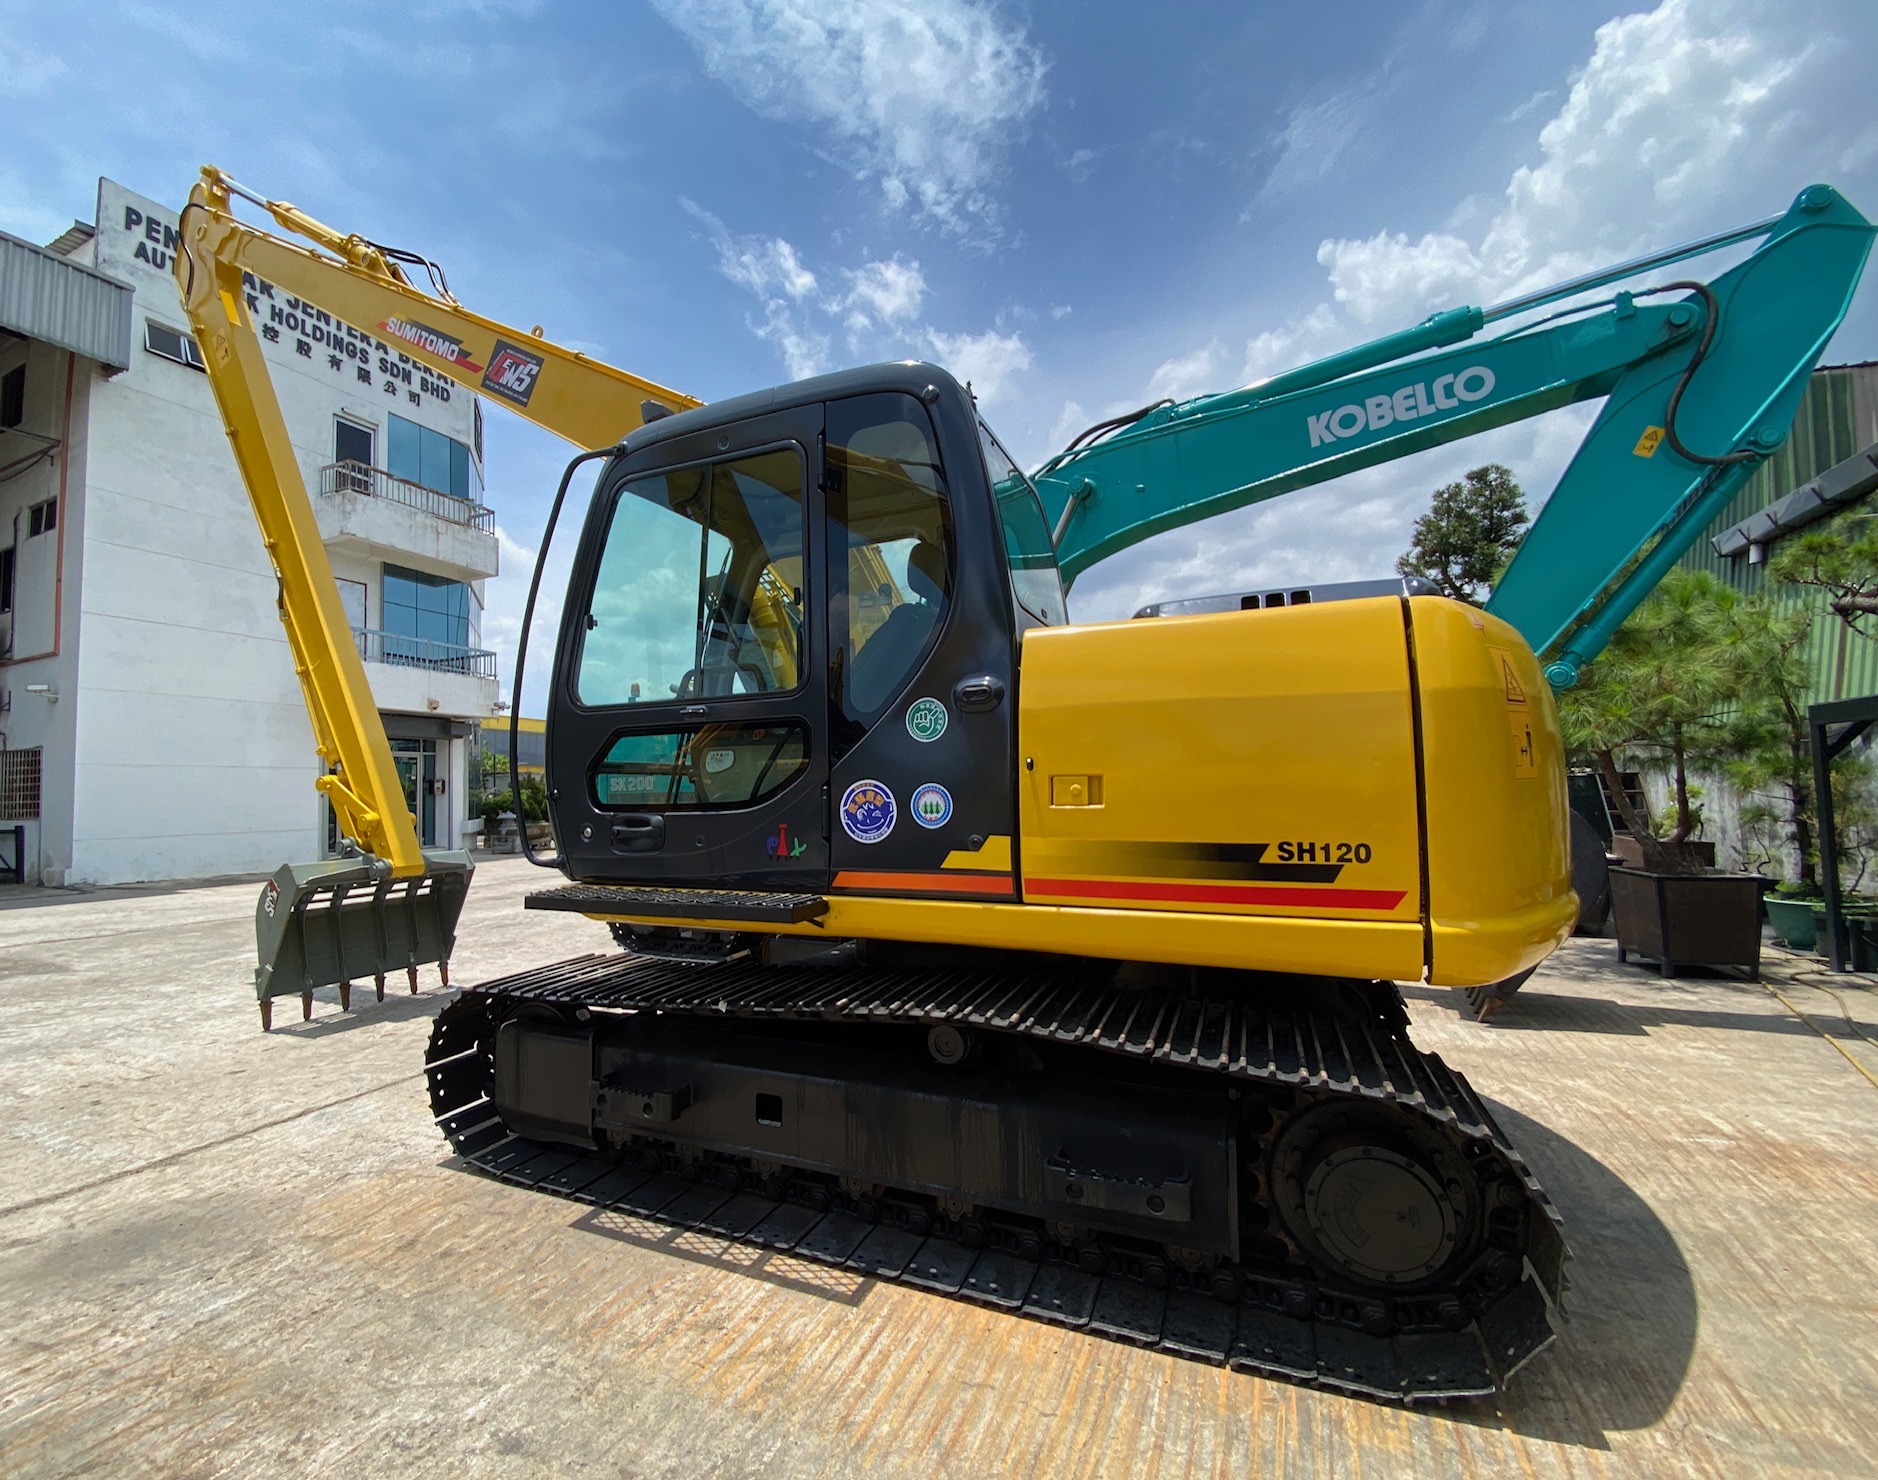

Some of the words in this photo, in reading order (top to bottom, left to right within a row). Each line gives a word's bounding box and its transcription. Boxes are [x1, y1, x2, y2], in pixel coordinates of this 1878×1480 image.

[271, 304, 369, 365] HOLDINGS
[379, 357, 411, 385] SDN
[421, 376, 450, 402] BHD
[386, 316, 459, 362] SUMITOMO
[1307, 366, 1496, 448] KOBELCO
[610, 775, 654, 792] SK200
[1277, 841, 1372, 864] SH120
